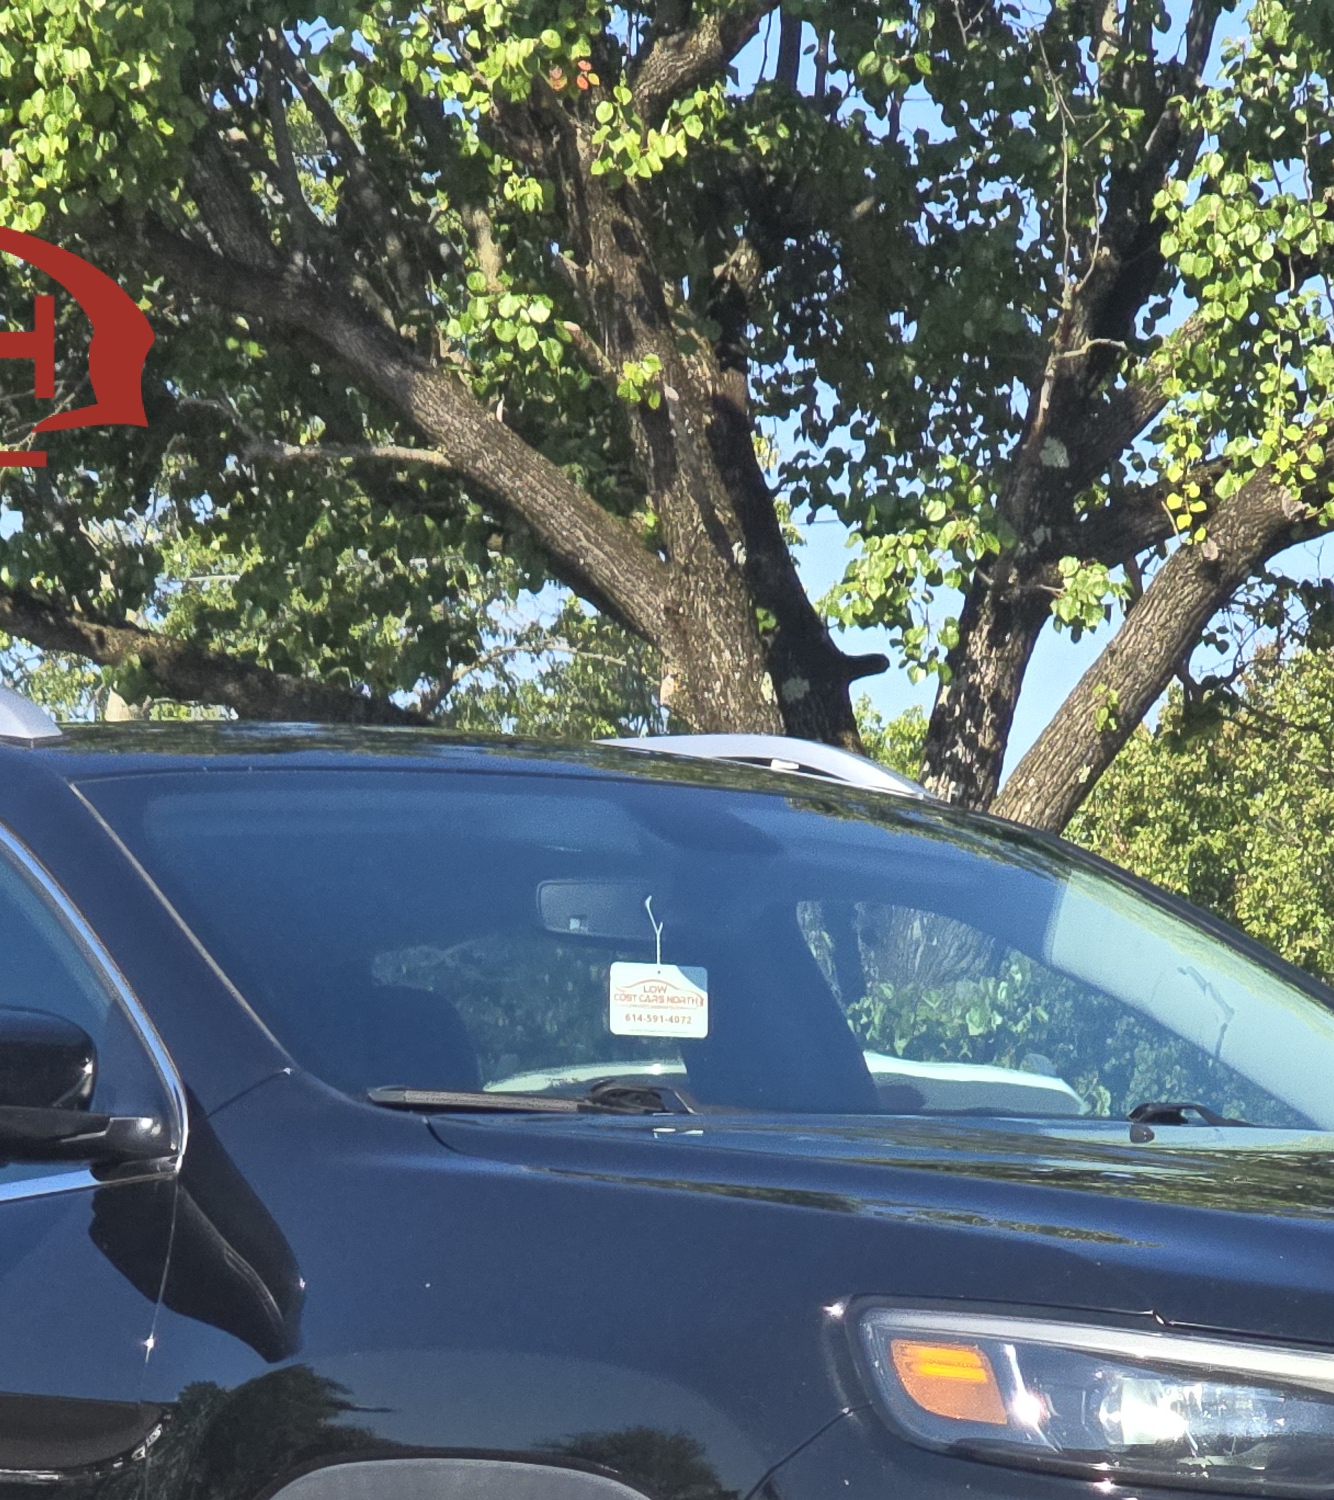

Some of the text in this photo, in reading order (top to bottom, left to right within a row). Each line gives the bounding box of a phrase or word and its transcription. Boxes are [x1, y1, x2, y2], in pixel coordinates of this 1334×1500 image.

[643, 985, 668, 994] LOW
[614, 992, 697, 1005] COST CARS NORTH
[624, 1013, 692, 1025] 614-591-4072
